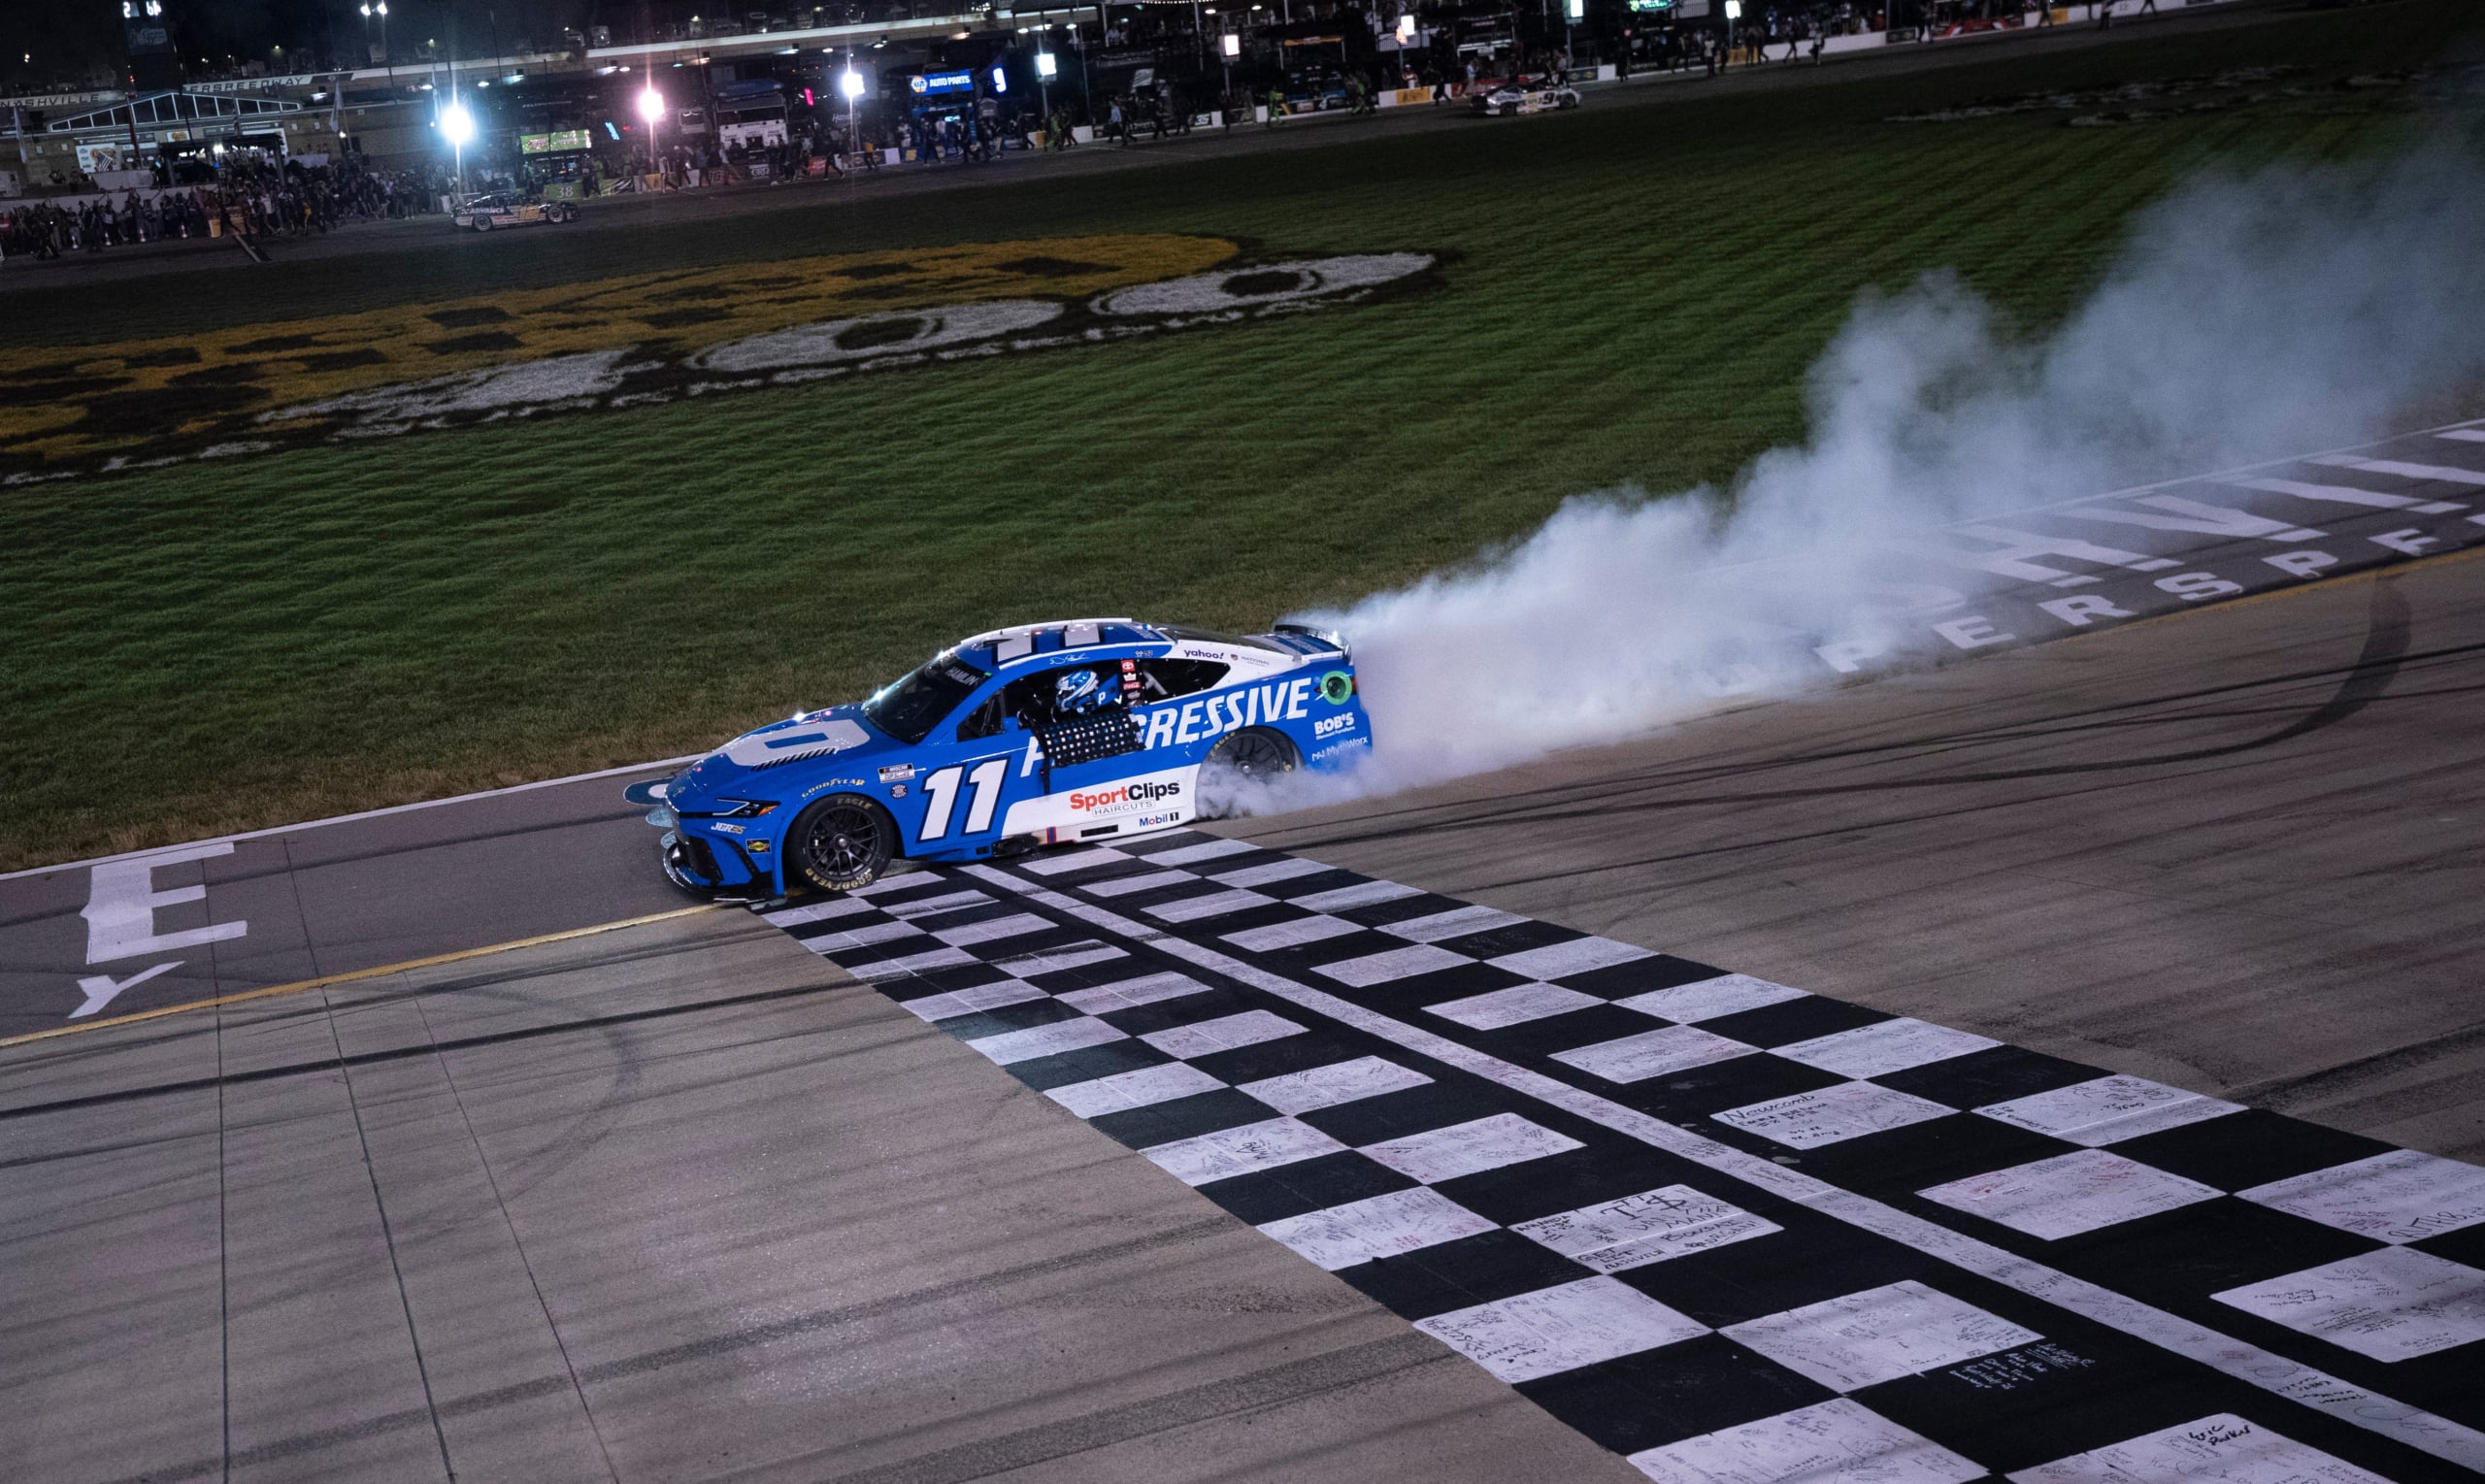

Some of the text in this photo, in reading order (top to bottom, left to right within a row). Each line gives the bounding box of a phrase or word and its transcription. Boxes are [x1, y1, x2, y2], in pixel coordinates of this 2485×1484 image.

[929, 75, 971, 87] AUTO PARTS
[992, 67, 1007, 93] 9
[0, 94, 97, 109] NASHVILLE
[557, 184, 573, 198] 38
[1184, 648, 1224, 660] yahoo!
[1314, 711, 1355, 735] BOB'S
[837, 797, 873, 810] EAGLE
[919, 758, 1008, 841] 11
[1070, 782, 1180, 811] SportClips
[1094, 801, 1154, 816] HAIRCUTS
[1139, 813, 1168, 827] Mobil
[805, 868, 873, 891] GOODYEAR
[1723, 1094, 1815, 1123] Newcomb
[1576, 1247, 1615, 1263] GET
